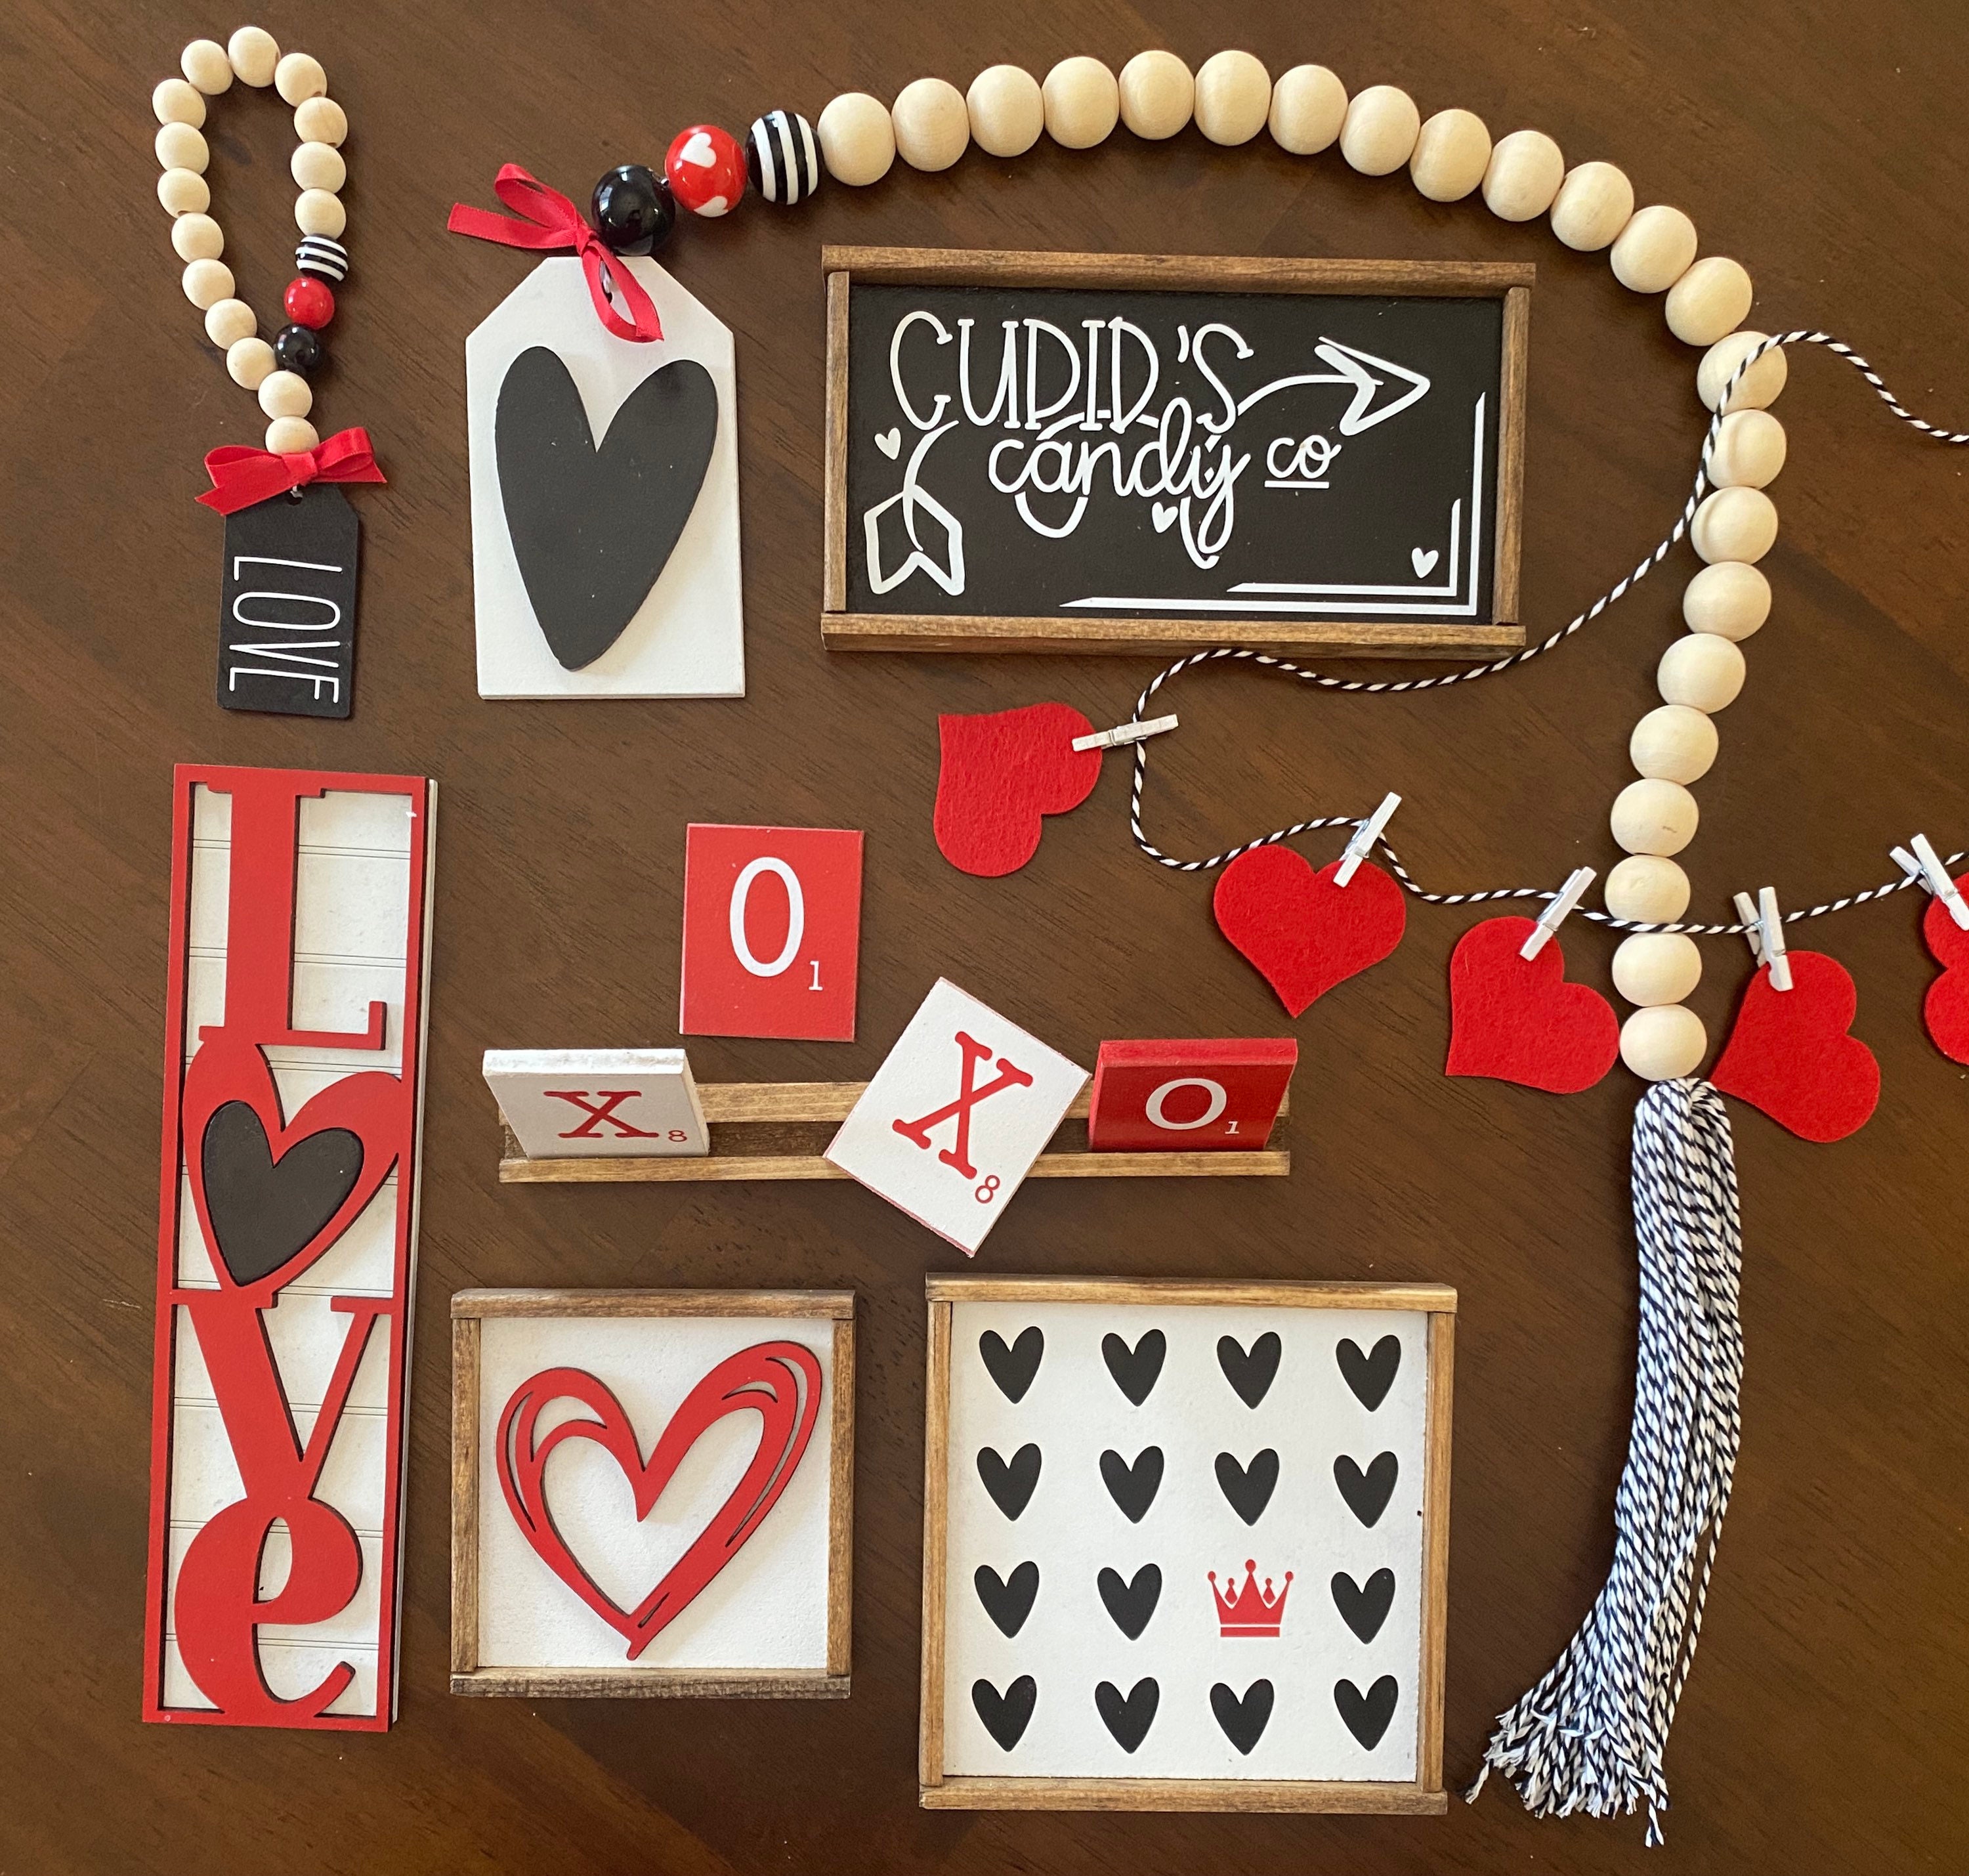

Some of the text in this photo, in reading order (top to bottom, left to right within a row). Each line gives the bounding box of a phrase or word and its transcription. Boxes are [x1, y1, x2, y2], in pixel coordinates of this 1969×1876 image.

[889, 310, 1254, 435] CUPID'S
[988, 396, 1342, 555] candy co
[229, 556, 343, 704] LOVE
[808, 960, 824, 991] 1
[543, 1090, 688, 1143] X 8
[892, 1031, 1034, 1204] X 8
[1224, 1120, 1240, 1135] 1
